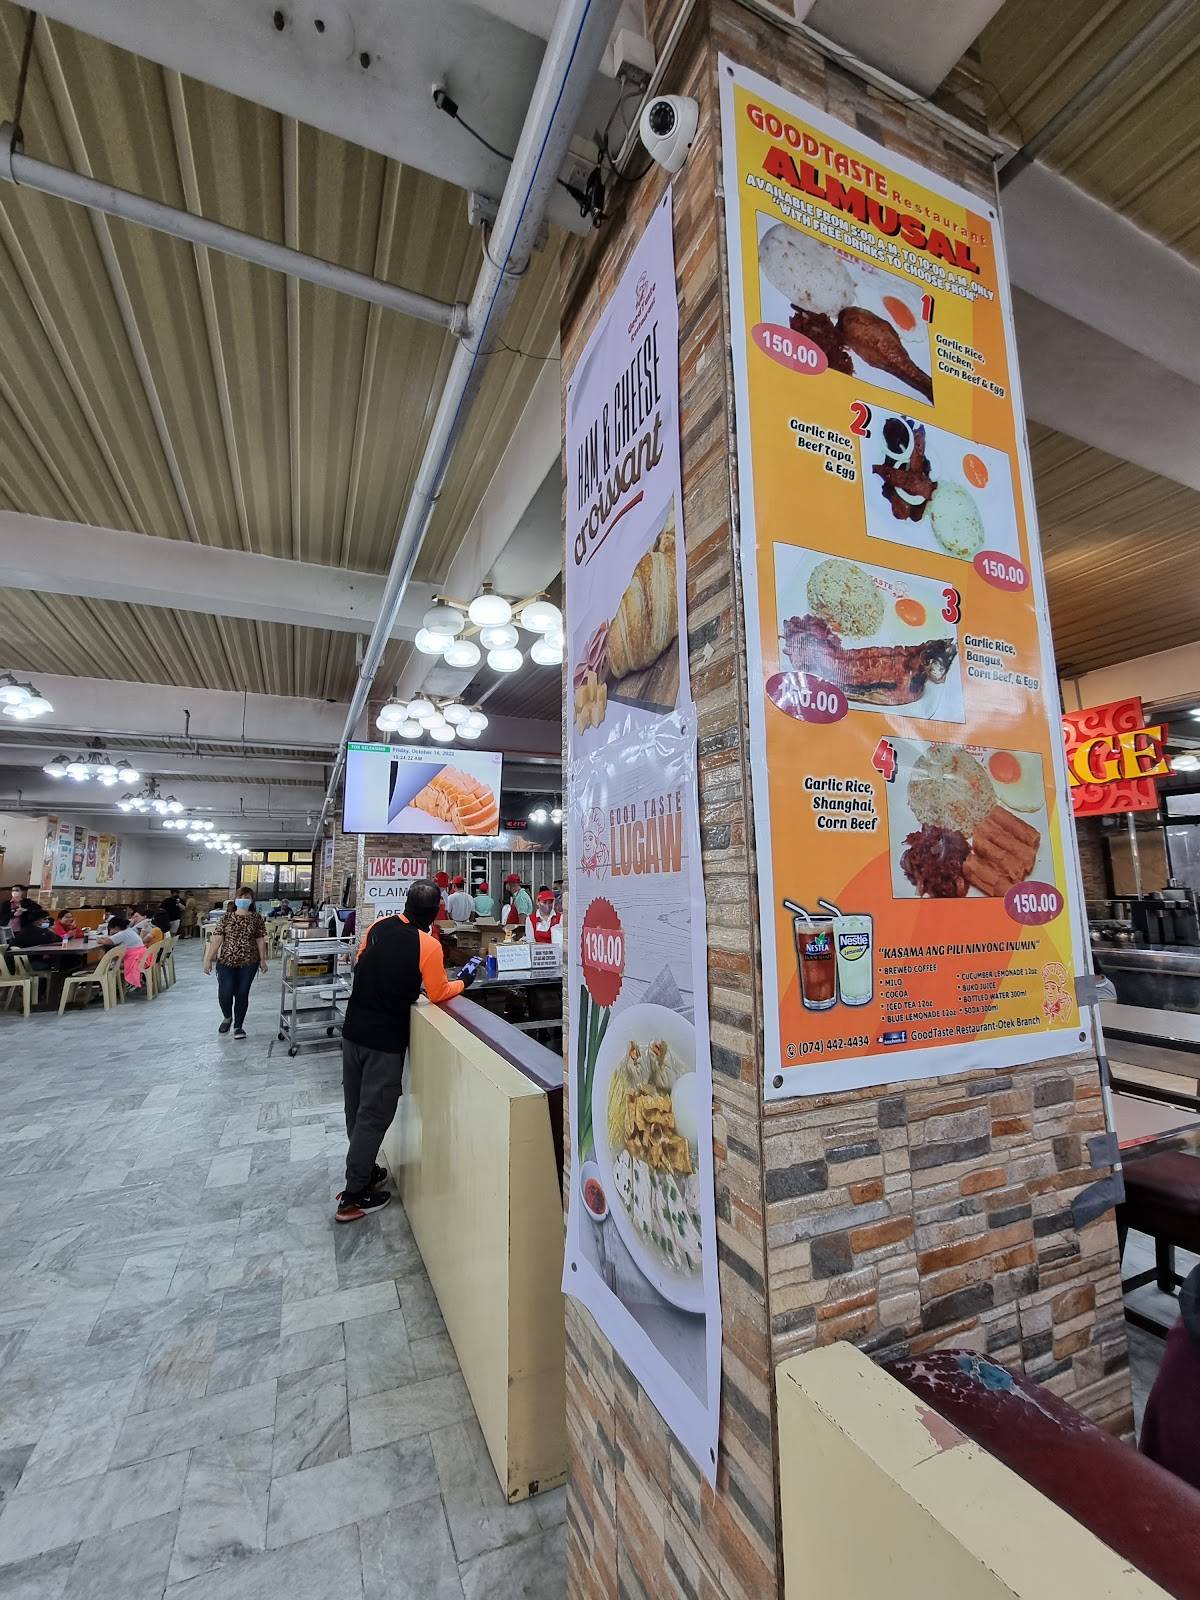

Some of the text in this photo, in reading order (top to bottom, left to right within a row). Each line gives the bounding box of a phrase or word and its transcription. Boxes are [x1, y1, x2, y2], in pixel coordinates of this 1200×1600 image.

[746, 103, 988, 247] GOODTASTE Restaurant
[762, 146, 980, 275] ALMUSAL
[746, 173, 815, 216] AVAILABLE
[815, 207, 850, 231] FROM
[850, 223, 876, 245] 5:00
[877, 239, 900, 255] A.M.
[902, 248, 918, 263] TO
[918, 257, 946, 279] 10:00
[970, 280, 994, 300] ONLY
[812, 219, 843, 242] FREE
[843, 233, 885, 262] DRINKS
[886, 255, 902, 269] TO
[903, 261, 945, 290] CHOOSE
[920, 293, 935, 323] 1
[762, 330, 819, 369] 150.00
[935, 334, 986, 365] Garlic Rice,
[937, 348, 975, 373] Chicken,
[938, 361, 1006, 398] Corn Beef & Egg
[578, 320, 662, 511] HAM & CHEESE
[849, 401, 872, 438] 2
[790, 419, 853, 450] Garlic Rice,
[798, 437, 854, 465] Beef Tapa,
[825, 461, 856, 480] & Egg
[573, 410, 664, 568] croissant
[981, 558, 1025, 585] 150.00
[941, 587, 962, 625] 3
[964, 634, 1016, 656] Garlic Rice,
[965, 650, 1003, 669] Bangus,
[967, 666, 992, 680] Corn
[1015, 674, 1023, 685] &
[1023, 675, 1040, 691] Egg
[871, 739, 898, 784] 4
[804, 777, 874, 796] Garlic Rice,
[609, 791, 682, 827] GOOD TASTE
[812, 796, 875, 815] Shanghai,
[817, 816, 878, 831] Corn Beef
[610, 811, 683, 877] LUGAW
[1013, 894, 1057, 914] 150.00
[585, 931, 623, 967] 130.00
[805, 943, 830, 952] NESTEA
[926, 945, 945, 956] ANG
[946, 944, 964, 955] PILI
[964, 942, 1005, 954] NINYONG
[884, 964, 937, 975] BREWED COFFEE
[961, 971, 993, 980] CUCUMBER
[994, 969, 1024, 978] LEMONADE
[885, 990, 909, 998] COCOA
[962, 982, 996, 992] BUKO JUICE
[963, 994, 989, 1002] BOTTLED
[989, 991, 1010, 1000] WATER
[886, 1000, 933, 1011] ICED TEA 12oz
[887, 1009, 956, 1023] BLUE LEMONADE 12oz
[1016, 1016, 1041, 1027] Branch
[799, 1042, 824, 1056] (074)
[826, 1035, 870, 1050] 442-4434
